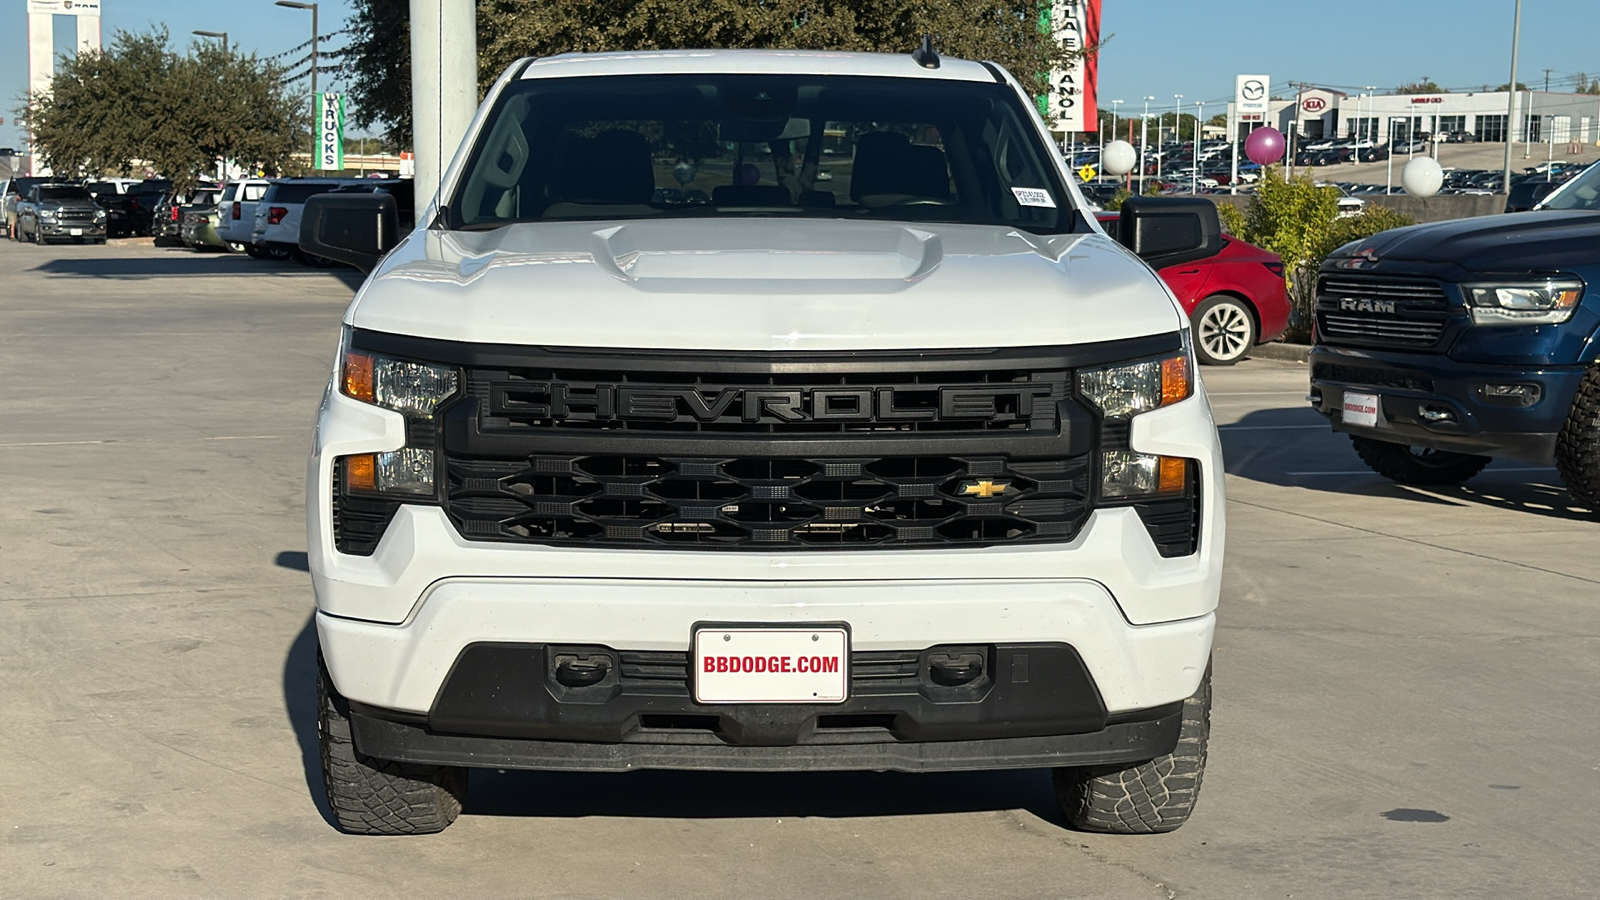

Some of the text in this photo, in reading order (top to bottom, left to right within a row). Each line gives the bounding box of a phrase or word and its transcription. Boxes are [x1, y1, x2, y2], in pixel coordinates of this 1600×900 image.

[1306, 100, 1322, 109] KIA
[324, 97, 335, 165] TRUCKS
[1340, 298, 1395, 314] RAM
[489, 380, 1054, 422] CHEVROLET
[703, 656, 839, 673] BBDODGE.COM
